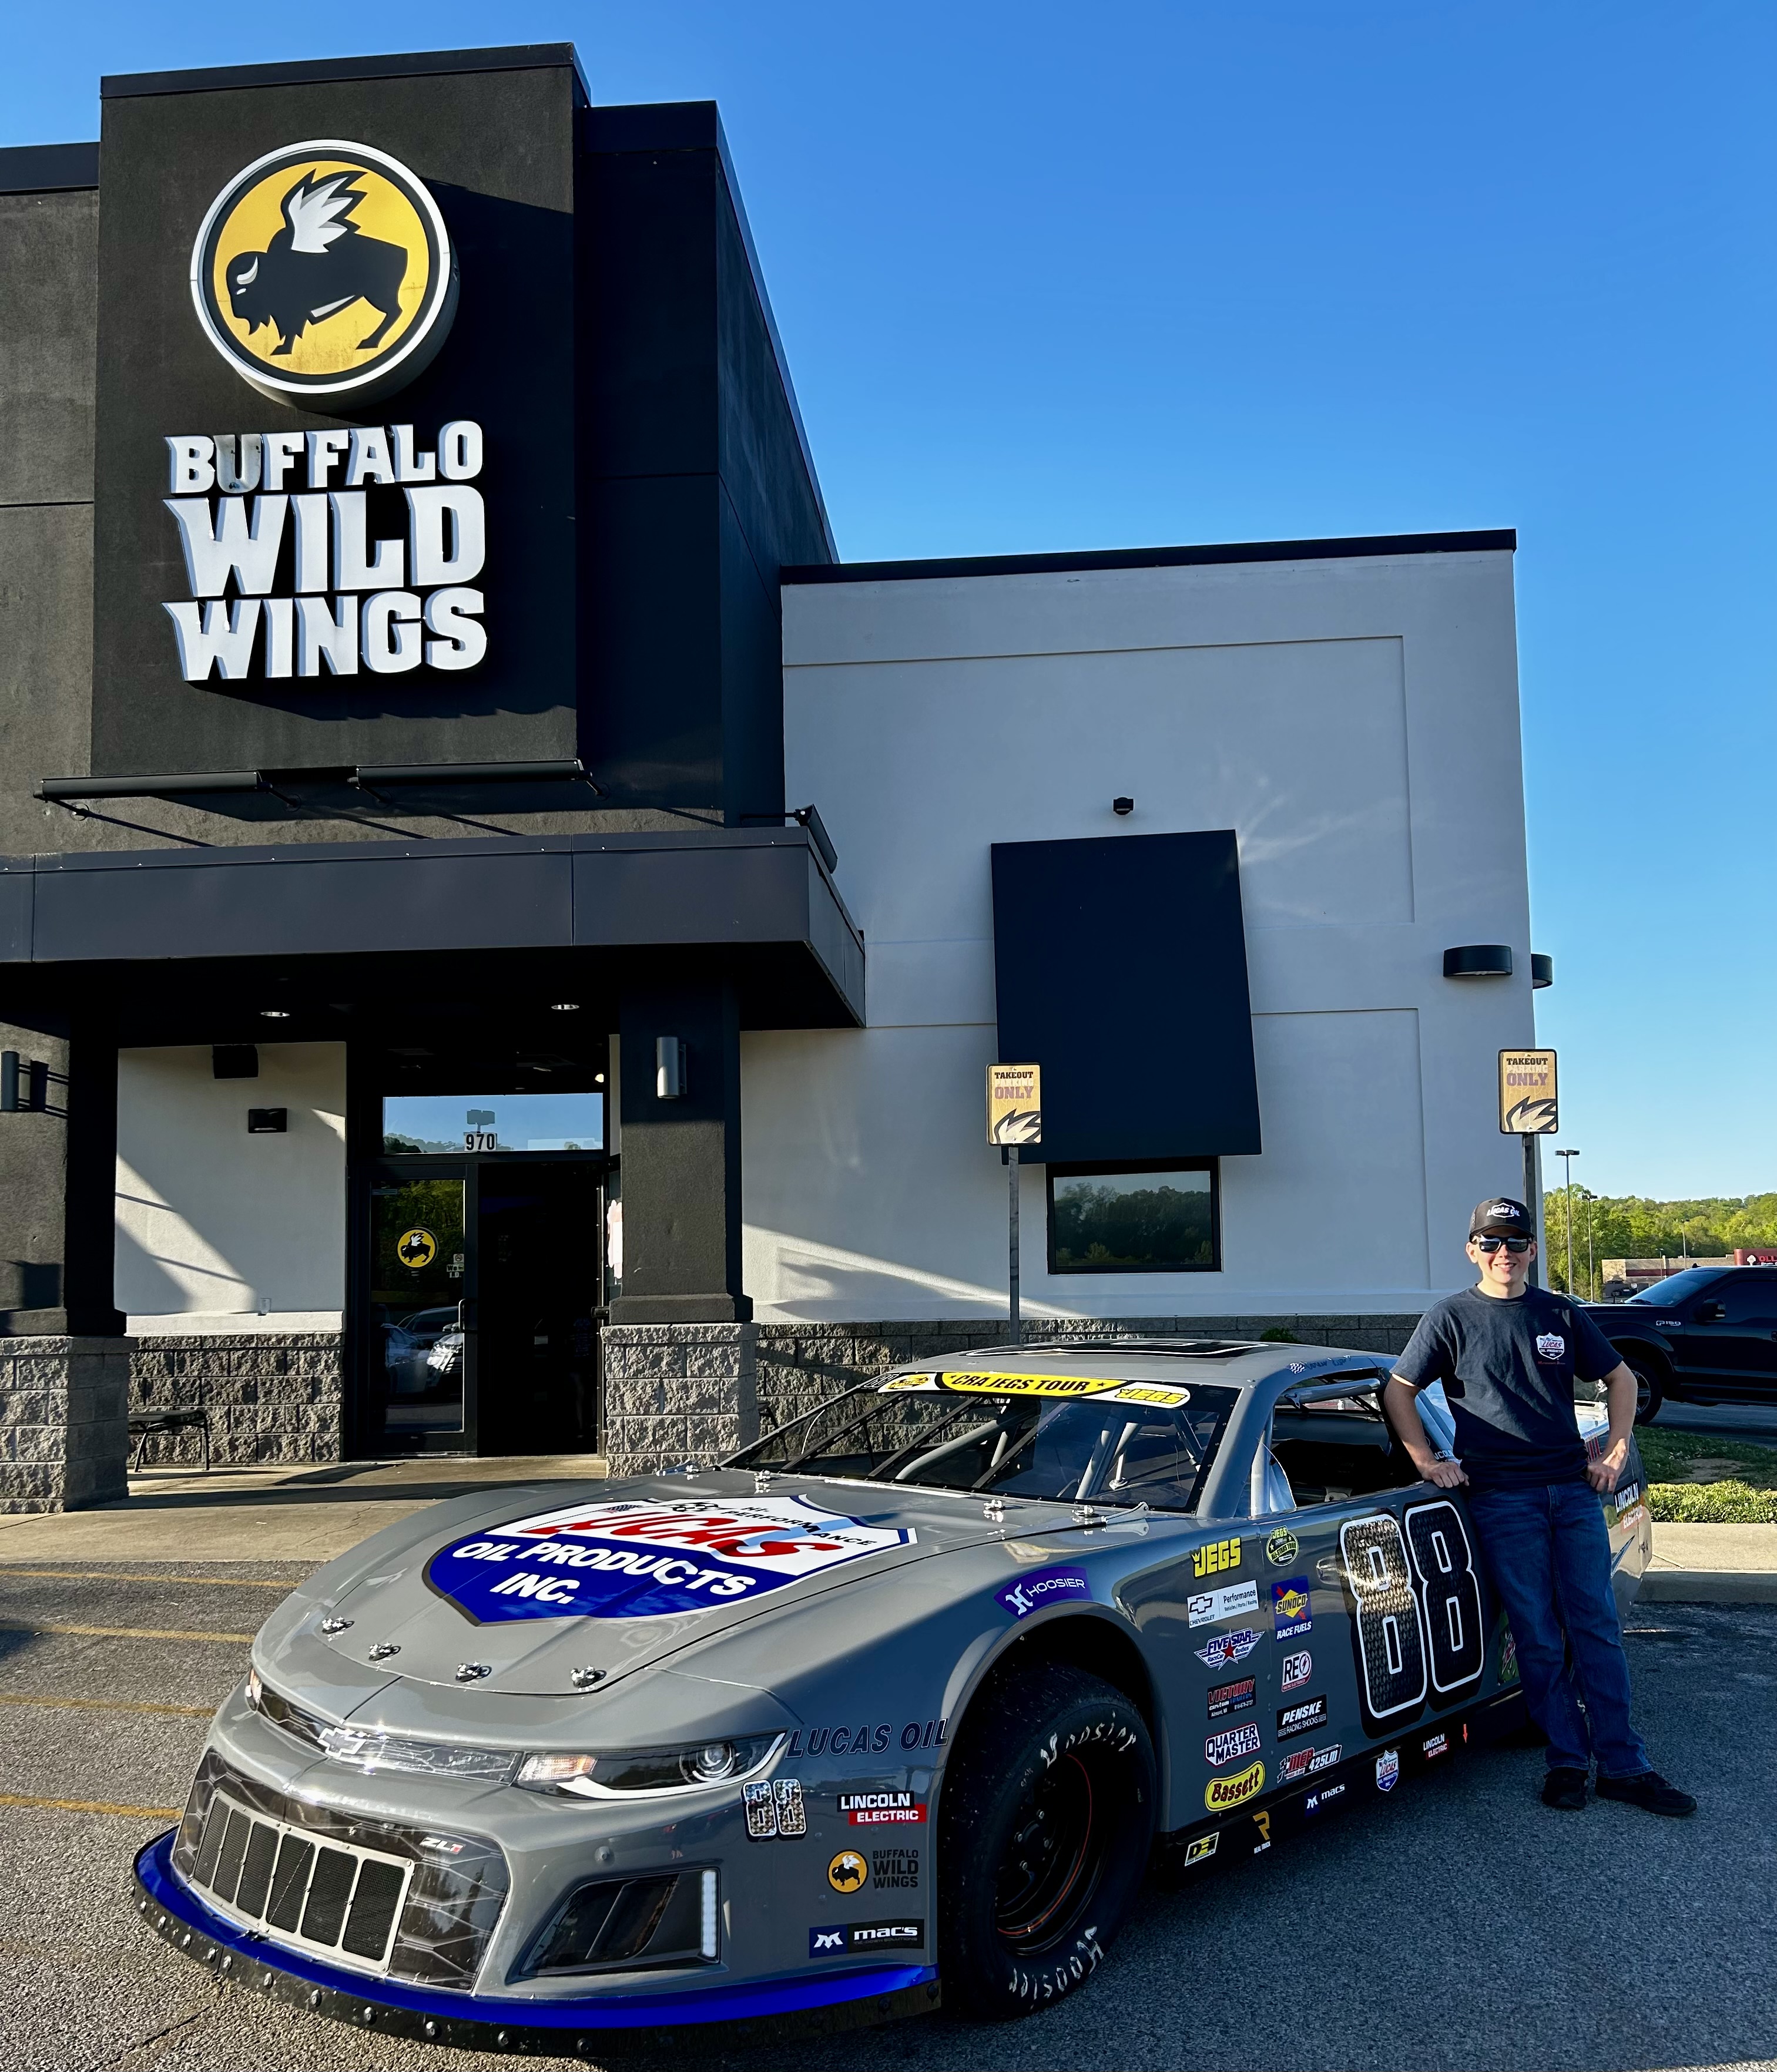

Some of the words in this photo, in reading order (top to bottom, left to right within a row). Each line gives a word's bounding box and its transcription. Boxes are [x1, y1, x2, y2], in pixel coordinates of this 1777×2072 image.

[163, 421, 483, 493] BUFFALO
[162, 485, 485, 597] WILD
[161, 587, 487, 681] WINGS
[1507, 1073, 1548, 1086] ONLY
[994, 1086, 1034, 1099] ONLY
[466, 1133, 495, 1150] 970
[1487, 1207, 1509, 1216] LUCAS
[951, 1375, 987, 1385] CRA
[990, 1378, 1034, 1389] JEGS
[1034, 1380, 1091, 1392] TOUR
[1115, 1388, 1188, 1405] JEGS
[1615, 1482, 1639, 1513] LINCOLN
[721, 1510, 877, 1546] PERFORMANCE
[1271, 1527, 1287, 1539] JEGS
[1192, 1537, 1240, 1577] JEGS
[452, 1542, 522, 1561] OIL
[515, 1542, 757, 1596] PRODUCTS
[489, 1573, 579, 1604] INC.
[1026, 1578, 1085, 1597] HOOSIER
[1223, 1589, 1256, 1603] Performance
[1277, 1594, 1307, 1613] SUNOCO
[1340, 1501, 1484, 1718] 88
[1189, 1614, 1215, 1626] CHEVROLET
[1276, 1627, 1293, 1640] RACE
[1294, 1621, 1312, 1634] FUELS
[1208, 1637, 1229, 1654] FIVE
[1231, 1630, 1252, 1645] STAR
[1208, 1678, 1255, 1704] VICTORY
[1282, 1700, 1322, 1725] PENSKE
[1287, 1722, 1302, 1734] RACING
[1302, 1716, 1318, 1728] SHOCKS
[785, 1723, 893, 1760] LUCAS
[900, 1718, 950, 1751] OIL
[1207, 1725, 1256, 1758] QUARTER
[1423, 1733, 1444, 1751] LINCOLN
[1216, 1736, 1258, 1764] MASTER
[1309, 1749, 1338, 1771] 425LM
[1212, 1767, 1259, 1802] Bassett
[743, 1779, 806, 1837] 88
[841, 1792, 910, 1810] LINCOLN
[856, 1810, 919, 1823] ELECTRIC
[419, 1837, 463, 1853] ZL1
[873, 1849, 918, 1859] BUFFALO
[873, 1859, 918, 1876] WILD
[873, 1875, 918, 1889] WINGS
